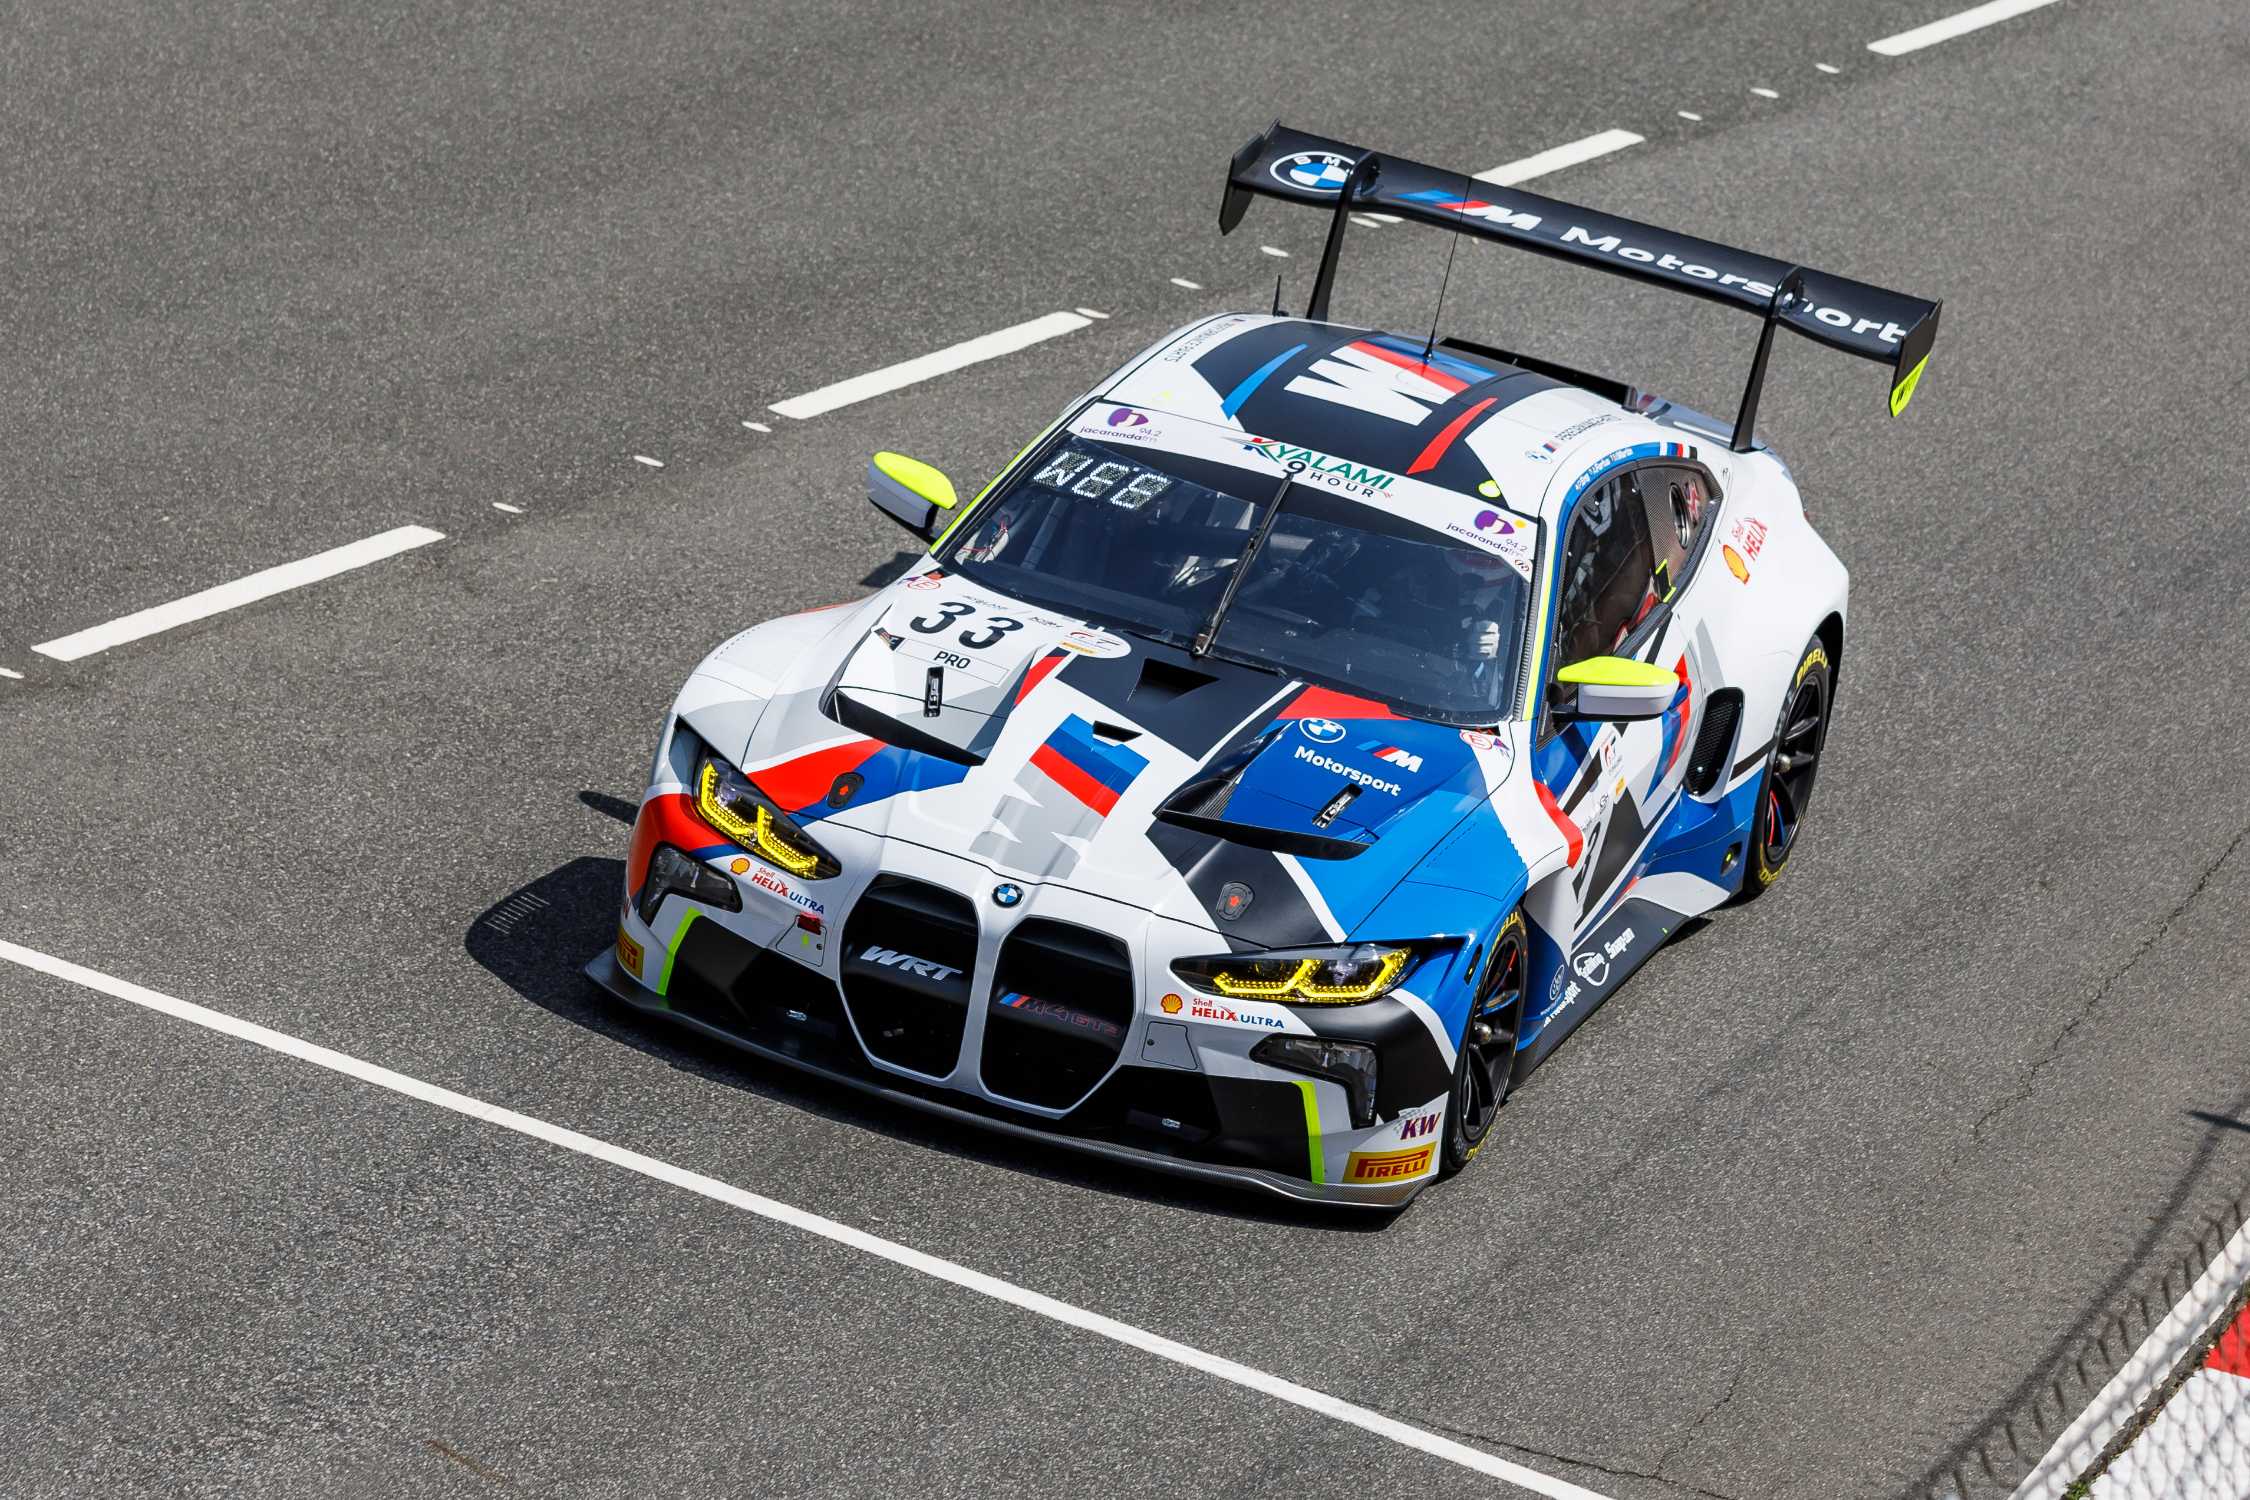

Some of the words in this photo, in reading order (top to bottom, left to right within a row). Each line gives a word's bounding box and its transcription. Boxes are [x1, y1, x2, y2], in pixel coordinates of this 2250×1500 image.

[1243, 437, 1395, 490] KYALAMI
[1309, 471, 1375, 498] HOUR
[909, 601, 1024, 650] 33
[934, 650, 971, 670] PRO
[1294, 745, 1402, 797] Motorsport
[751, 873, 789, 898] HELIX
[789, 891, 825, 915] ULTRA
[859, 945, 964, 981] WRT
[1191, 1005, 1239, 1022] HELIX
[1240, 1014, 1285, 1029] ULTRA
[1400, 1111, 1442, 1140] KW
[1354, 1149, 1430, 1178] PIRELLI
